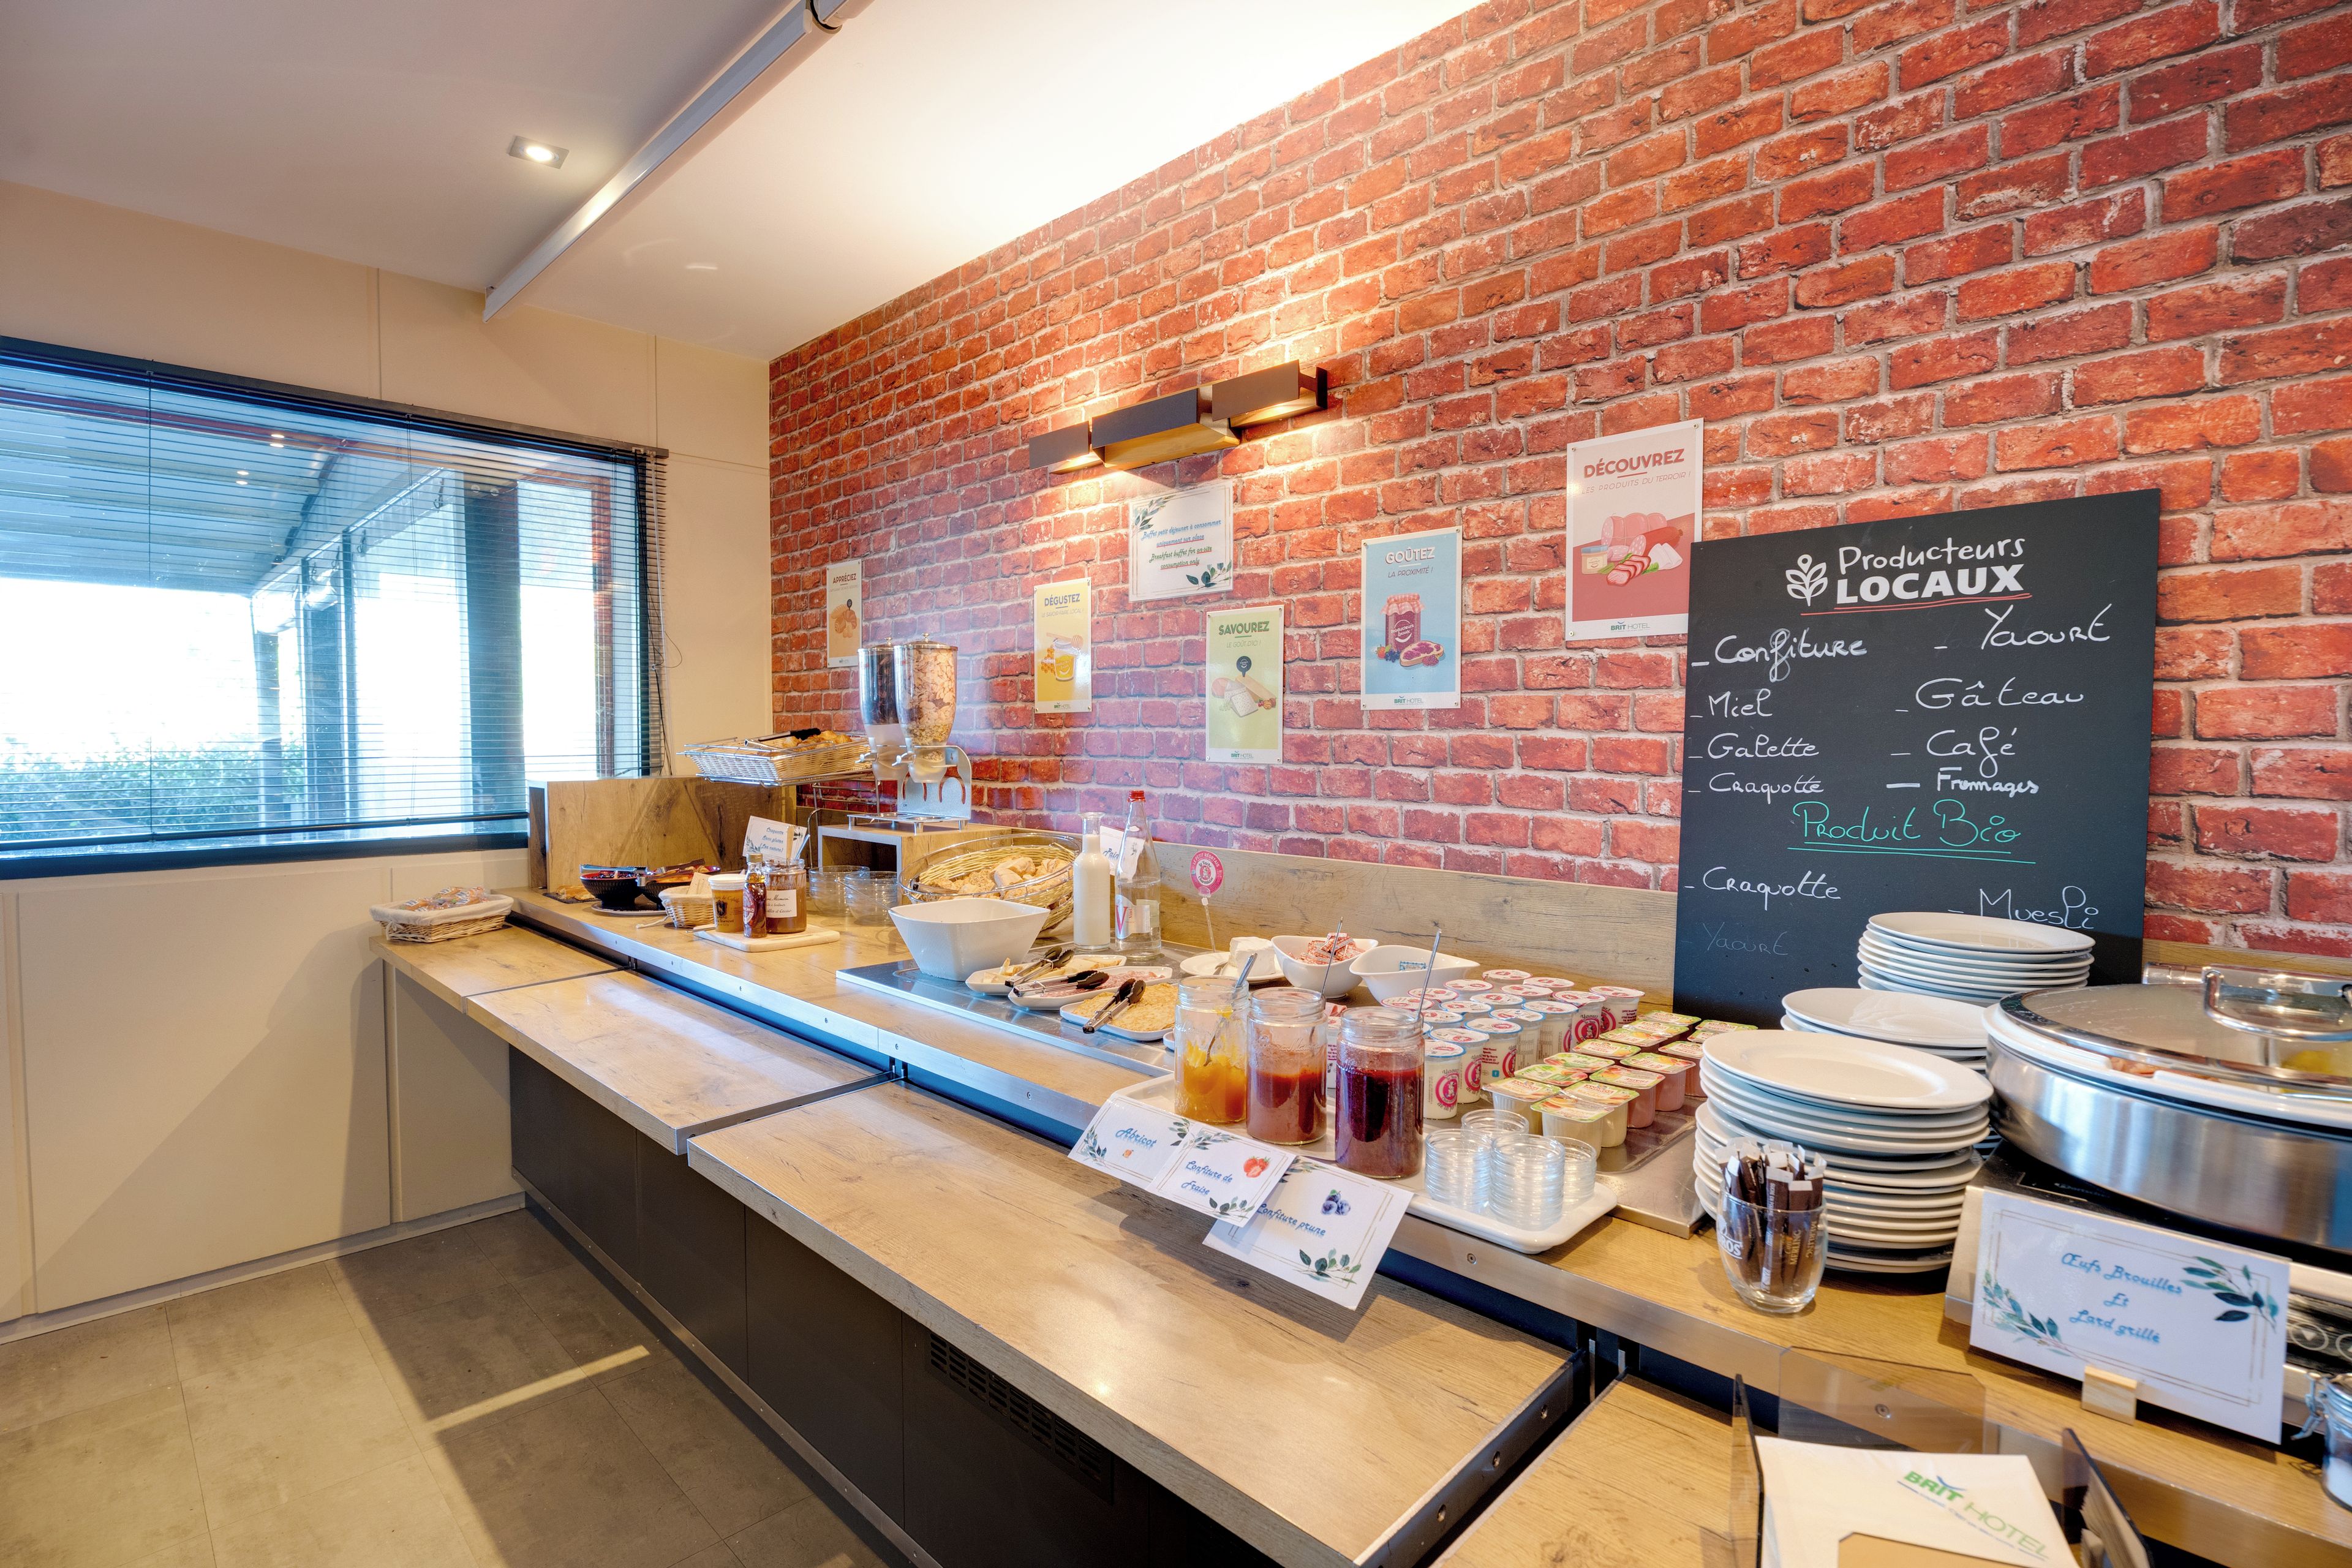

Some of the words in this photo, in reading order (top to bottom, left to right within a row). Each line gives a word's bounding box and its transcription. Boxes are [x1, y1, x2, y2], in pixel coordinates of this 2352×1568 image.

[1584, 448, 1684, 478] DÉCOUVREZ
[1599, 479, 1639, 491] PRODUITS
[1656, 472, 1686, 482] TERROIR
[1140, 531, 1157, 541] Buffet
[1157, 529, 1168, 537] petit
[1169, 526, 1189, 535] déjeuner
[1194, 520, 1221, 529] consommer
[1156, 537, 1182, 547] uniquement
[1149, 552, 1173, 563] Breakfast
[1174, 549, 1187, 557] buffet
[1160, 560, 1188, 569] consumption
[1189, 558, 1200, 567] only
[1385, 546, 1435, 564] GOÛTEZ
[1839, 537, 2026, 575] Producteurs
[833, 572, 856, 584] APPRÉCIEZ
[1398, 565, 1430, 577] PROXIMITÉ
[1837, 564, 2024, 605] LOCAUX
[1044, 594, 1080, 606] DÉGUSTEZ
[1218, 621, 1270, 635] SAVOUREZ
[1391, 624, 1414, 633] Producteurs
[1980, 603, 2112, 650] Yaourt
[1715, 628, 1868, 682] Confiture
[1708, 688, 1773, 717] Miel
[1915, 677, 2084, 709] Gâteau
[1708, 733, 1820, 758] Galette
[1926, 726, 2018, 778] Café
[1709, 772, 1824, 804] Craquotte
[1793, 801, 1921, 842] Produit
[1933, 799, 2021, 847] Bio
[1703, 867, 1841, 910] Craquotte
[1980, 886, 2099, 930] Muesli
[1703, 922, 1789, 956] Yaourt
[1115, 1128, 1157, 1148] Abricot
[1186, 1161, 1221, 1180] Confiture
[1223, 1174, 1233, 1182] de
[1180, 1180, 1210, 1195] Fraise
[1256, 1203, 1298, 1226] Confiture
[1298, 1222, 1326, 1236] prune
[2062, 1253, 2101, 1273] Œufs
[2103, 1265, 2182, 1294] Brouilles
[2103, 1292, 2129, 1307] Et
[2068, 1310, 2116, 1329] Lard
[2114, 1325, 2160, 1343] grillé
[1904, 1471, 1964, 1501] BRIT
[1964, 1502, 2049, 1560] HOTEL
